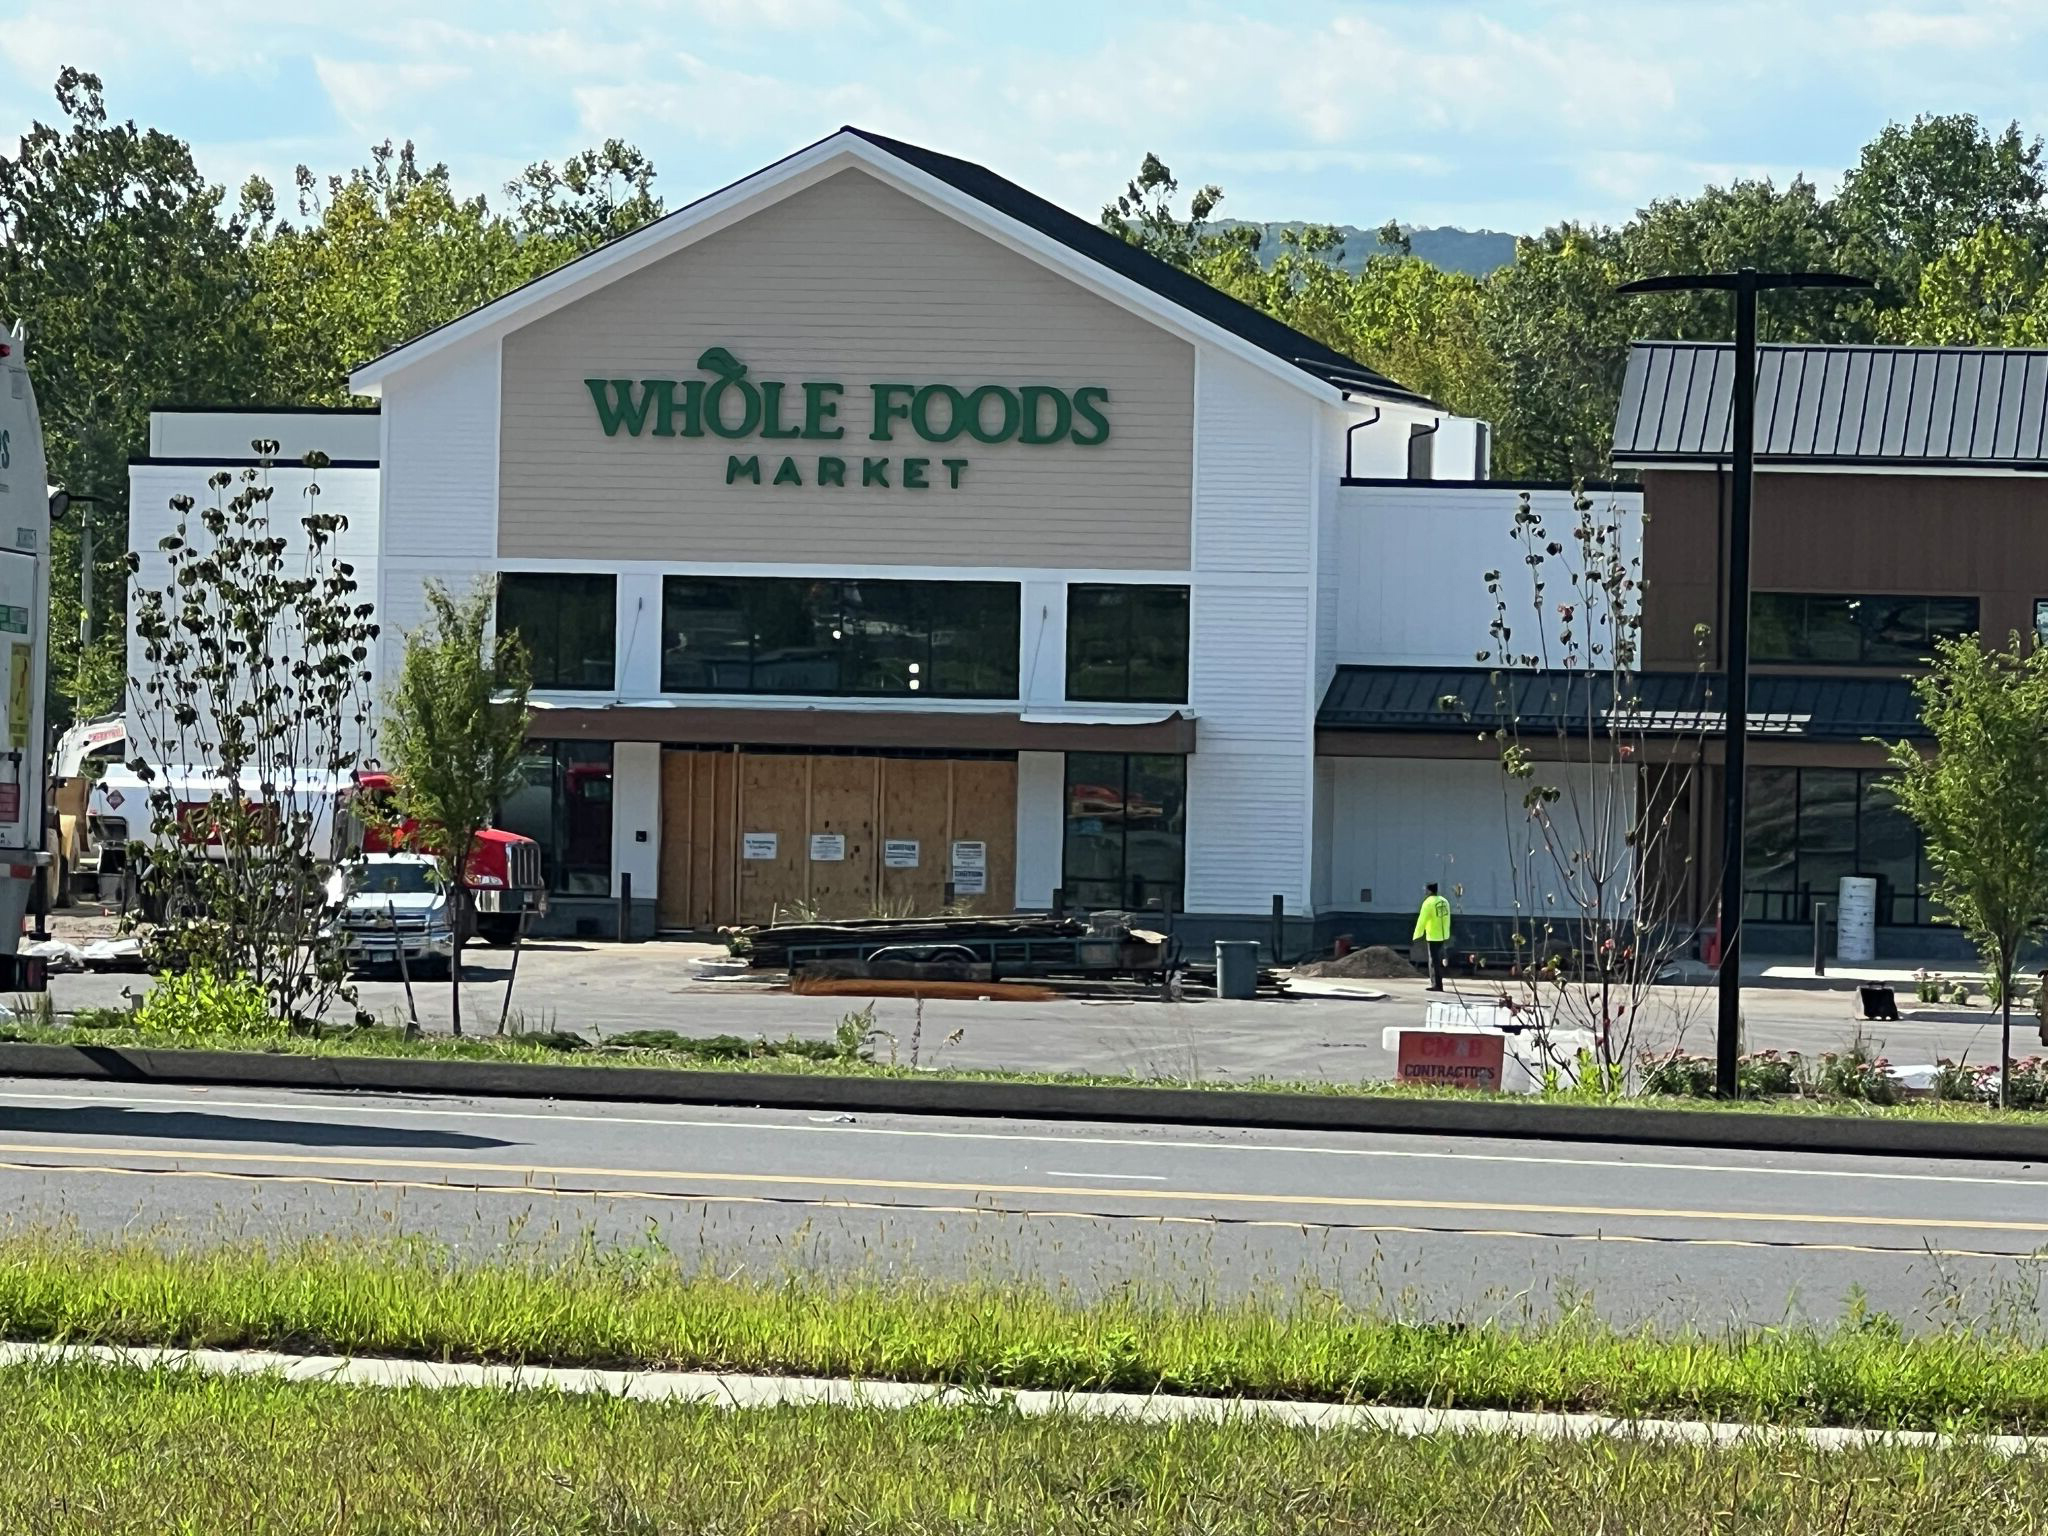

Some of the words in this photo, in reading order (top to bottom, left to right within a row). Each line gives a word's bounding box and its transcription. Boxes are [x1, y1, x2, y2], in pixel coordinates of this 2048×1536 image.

[584, 347, 845, 441] WHOLE
[868, 382, 1111, 446] FOODS
[726, 455, 969, 489] MARKET
